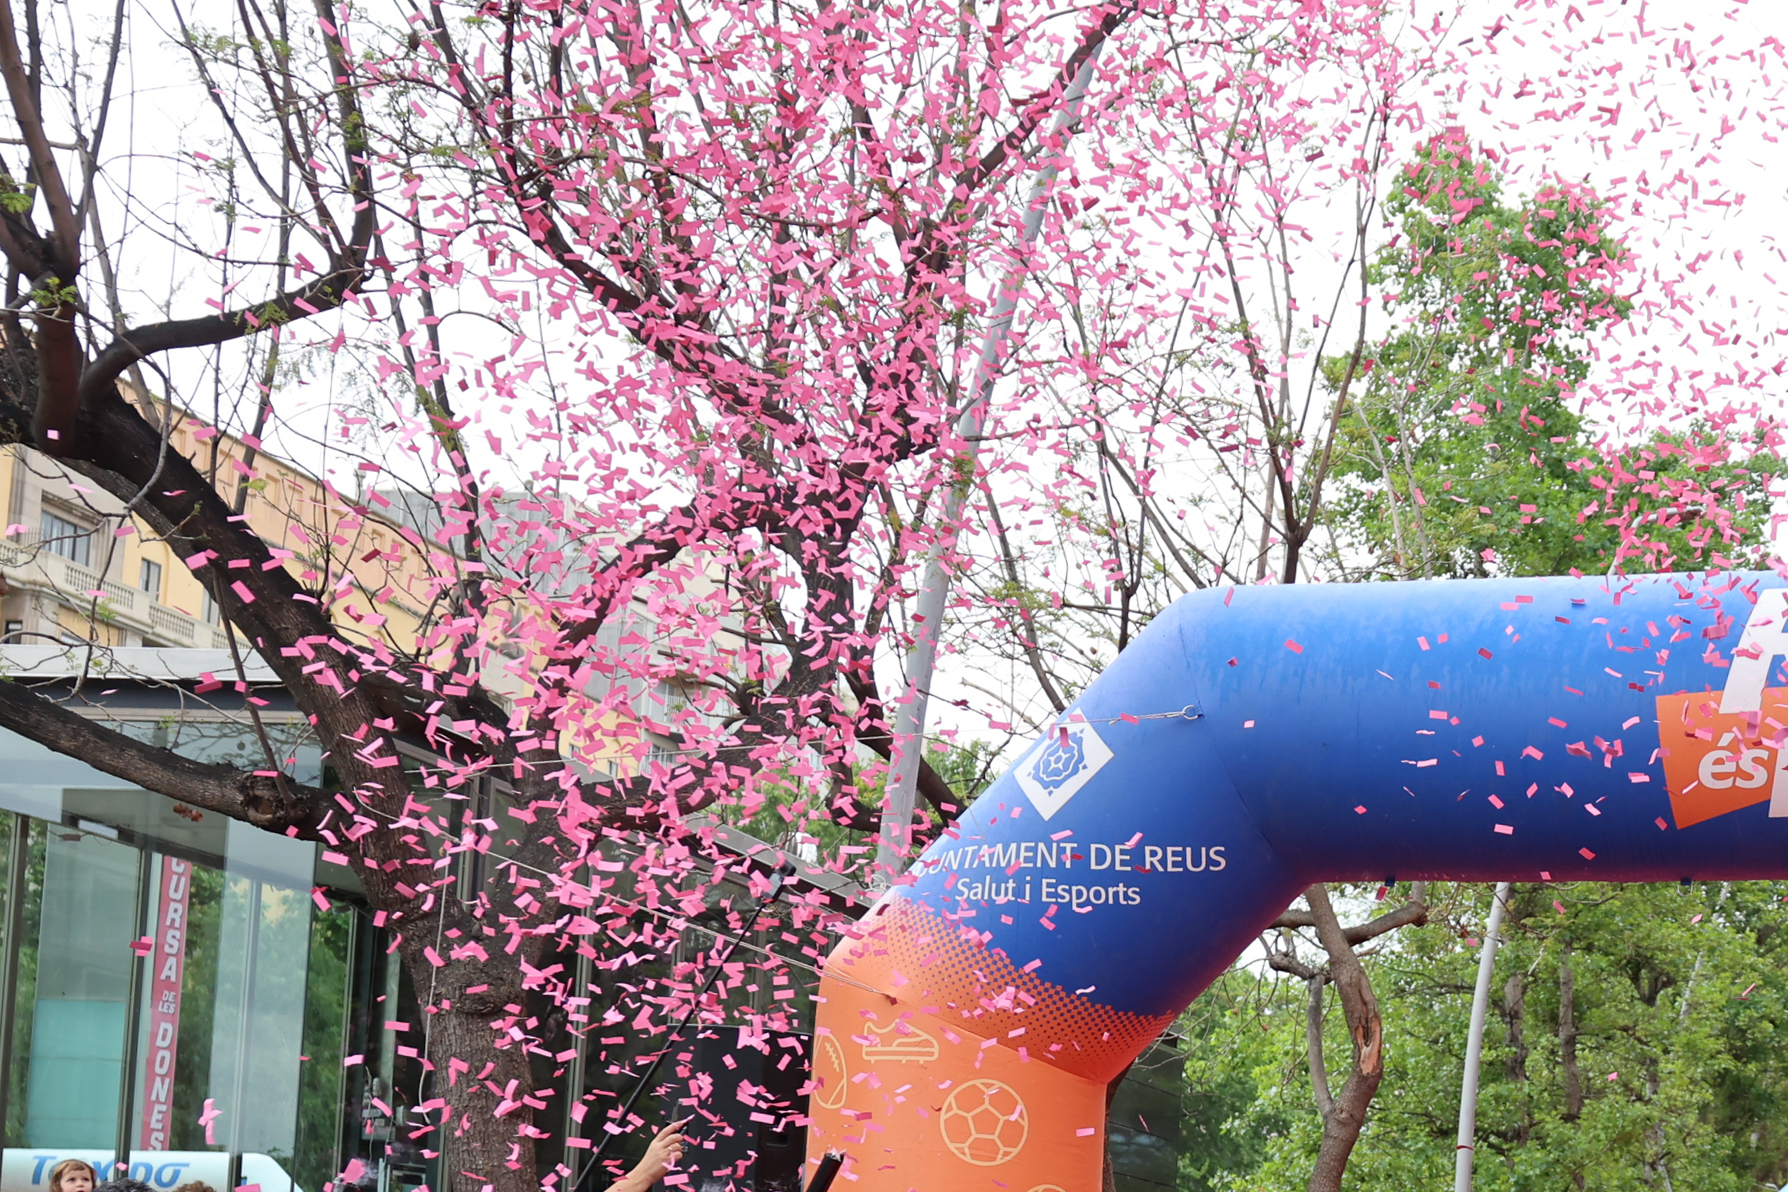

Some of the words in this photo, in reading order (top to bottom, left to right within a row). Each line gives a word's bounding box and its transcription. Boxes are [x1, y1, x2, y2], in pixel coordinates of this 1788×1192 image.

[1698, 731, 1769, 790] és
[1089, 844, 1131, 872] DE
[1144, 845, 1227, 873] REUS
[955, 876, 1016, 901] Salut
[1025, 876, 1031, 901] i
[1041, 878, 1141, 909] Esports
[158, 1001, 176, 1015] LES
[162, 990, 176, 1002] DE
[148, 1022, 174, 1150] DONES
